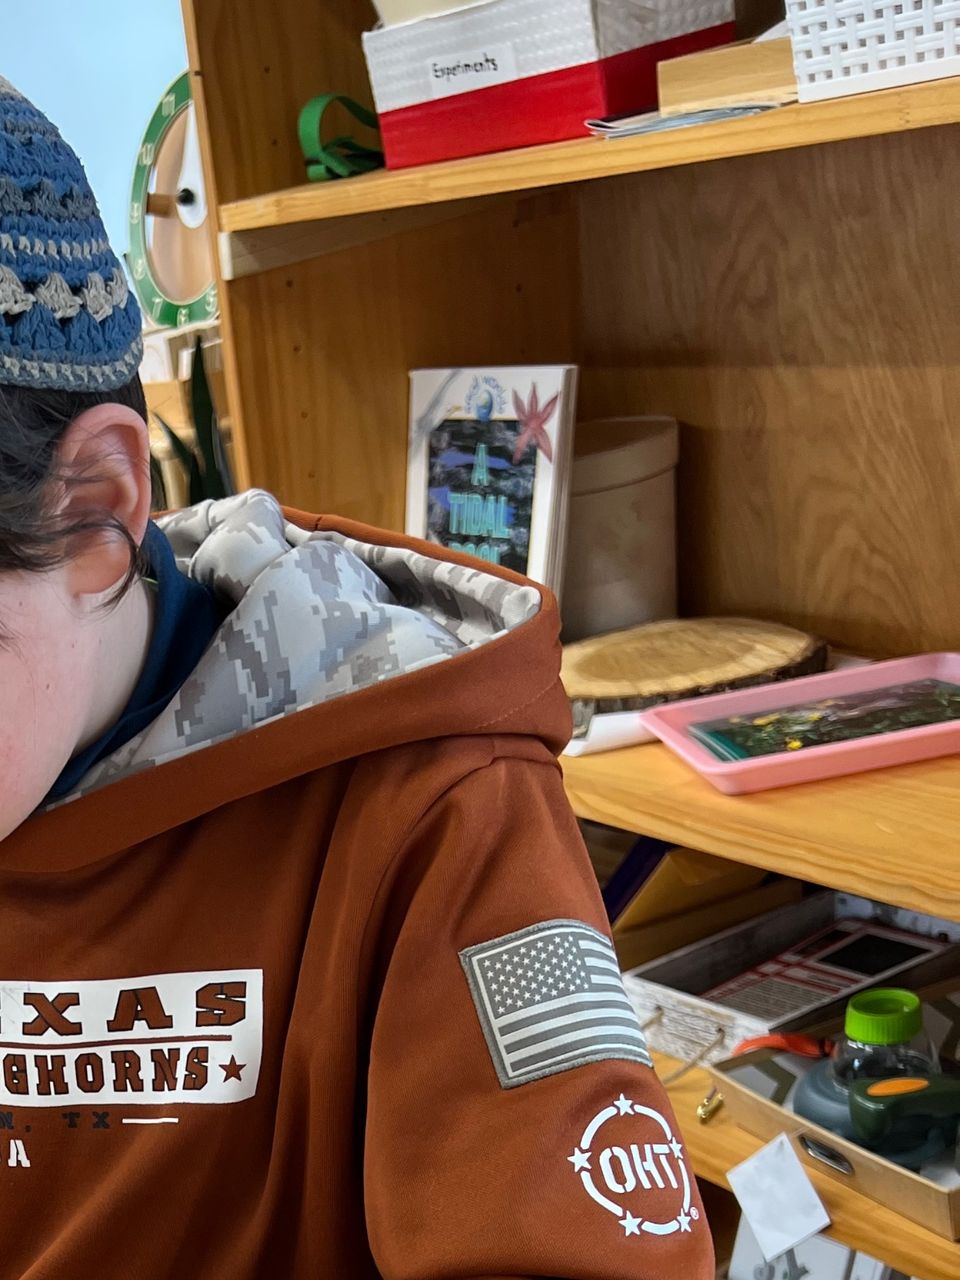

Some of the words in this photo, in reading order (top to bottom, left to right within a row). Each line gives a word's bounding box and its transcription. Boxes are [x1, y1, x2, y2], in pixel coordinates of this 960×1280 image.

[471, 444, 489, 487] A
[448, 491, 512, 539] TIDAL
[61, 1111, 111, 1129] TX
[599, 1144, 678, 1194] OHT
